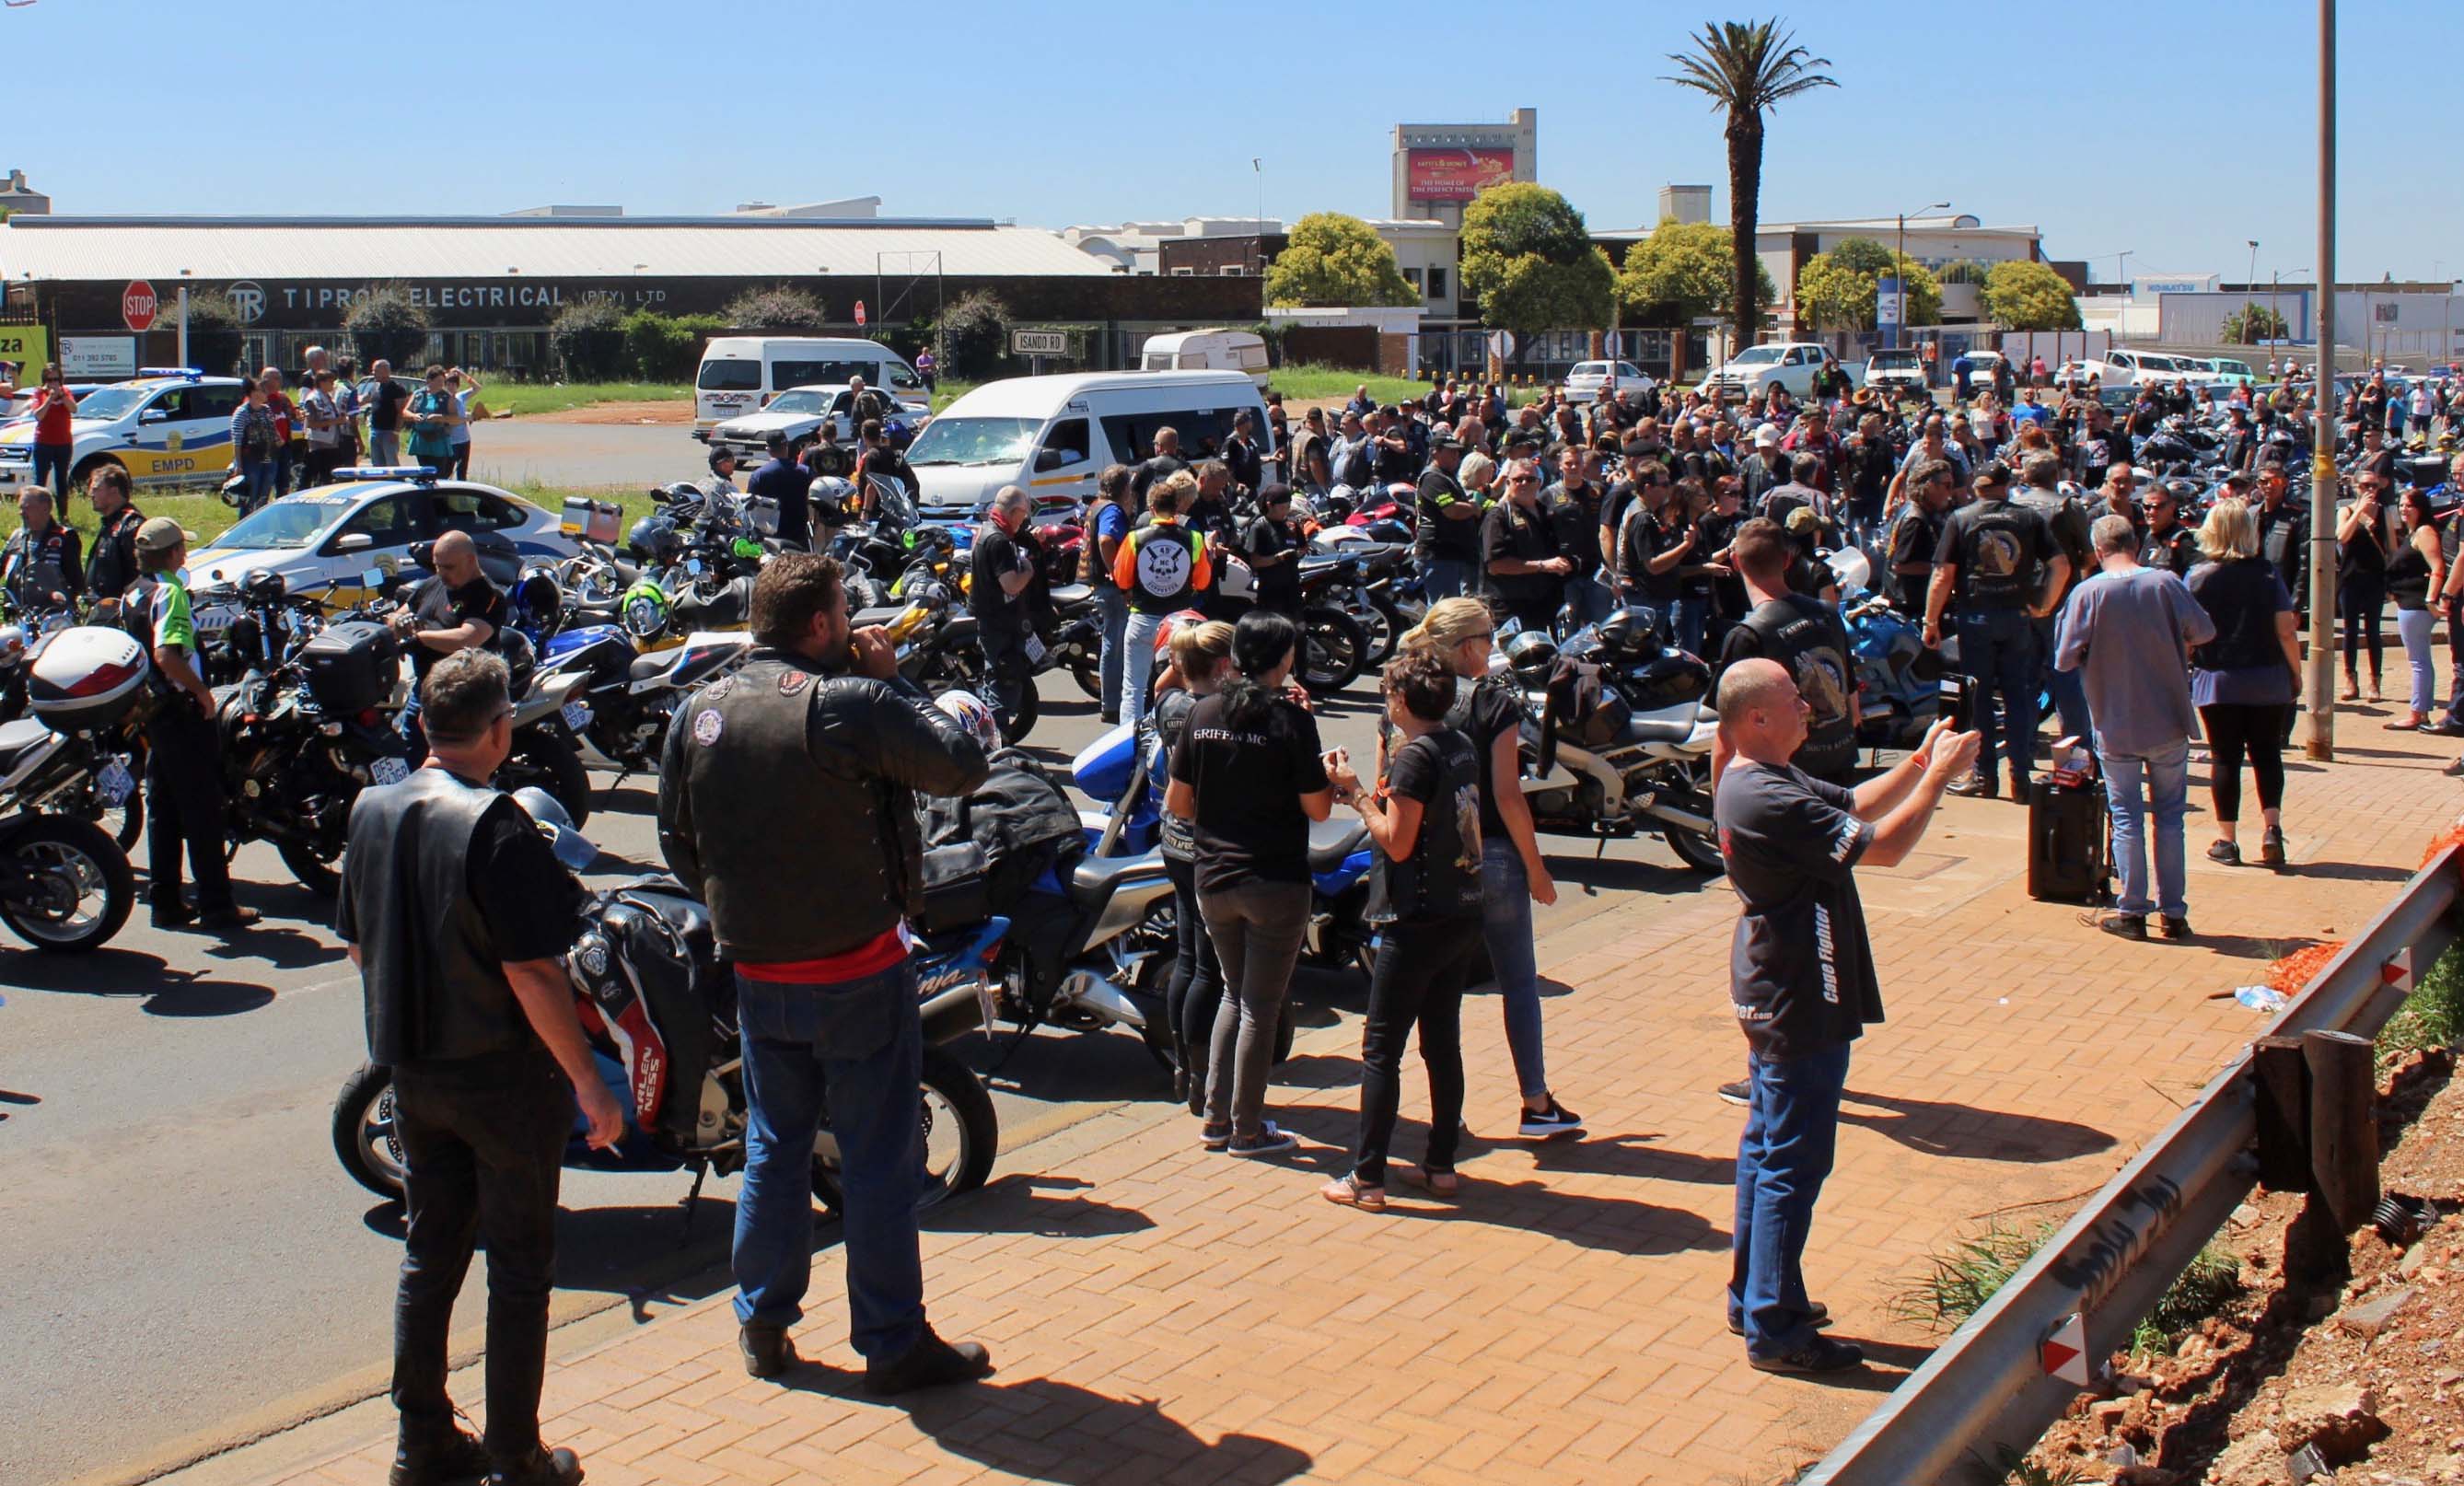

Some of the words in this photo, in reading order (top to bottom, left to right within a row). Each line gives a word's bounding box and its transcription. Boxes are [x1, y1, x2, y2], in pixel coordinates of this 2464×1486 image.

[127, 296, 153, 316] STOP
[410, 286, 564, 308] ELECTRICAL
[636, 290, 666, 302] LTD
[1020, 334, 1047, 350] ISANDO
[1051, 335, 1061, 350] RD
[152, 458, 195, 472] EMPD
[1194, 728, 1242, 742] GRIFFIN
[1247, 733, 1268, 746] MC
[1814, 902, 1834, 962] Fighter
[1821, 963, 1839, 1004] Cage
[645, 1058, 661, 1111] NESS
